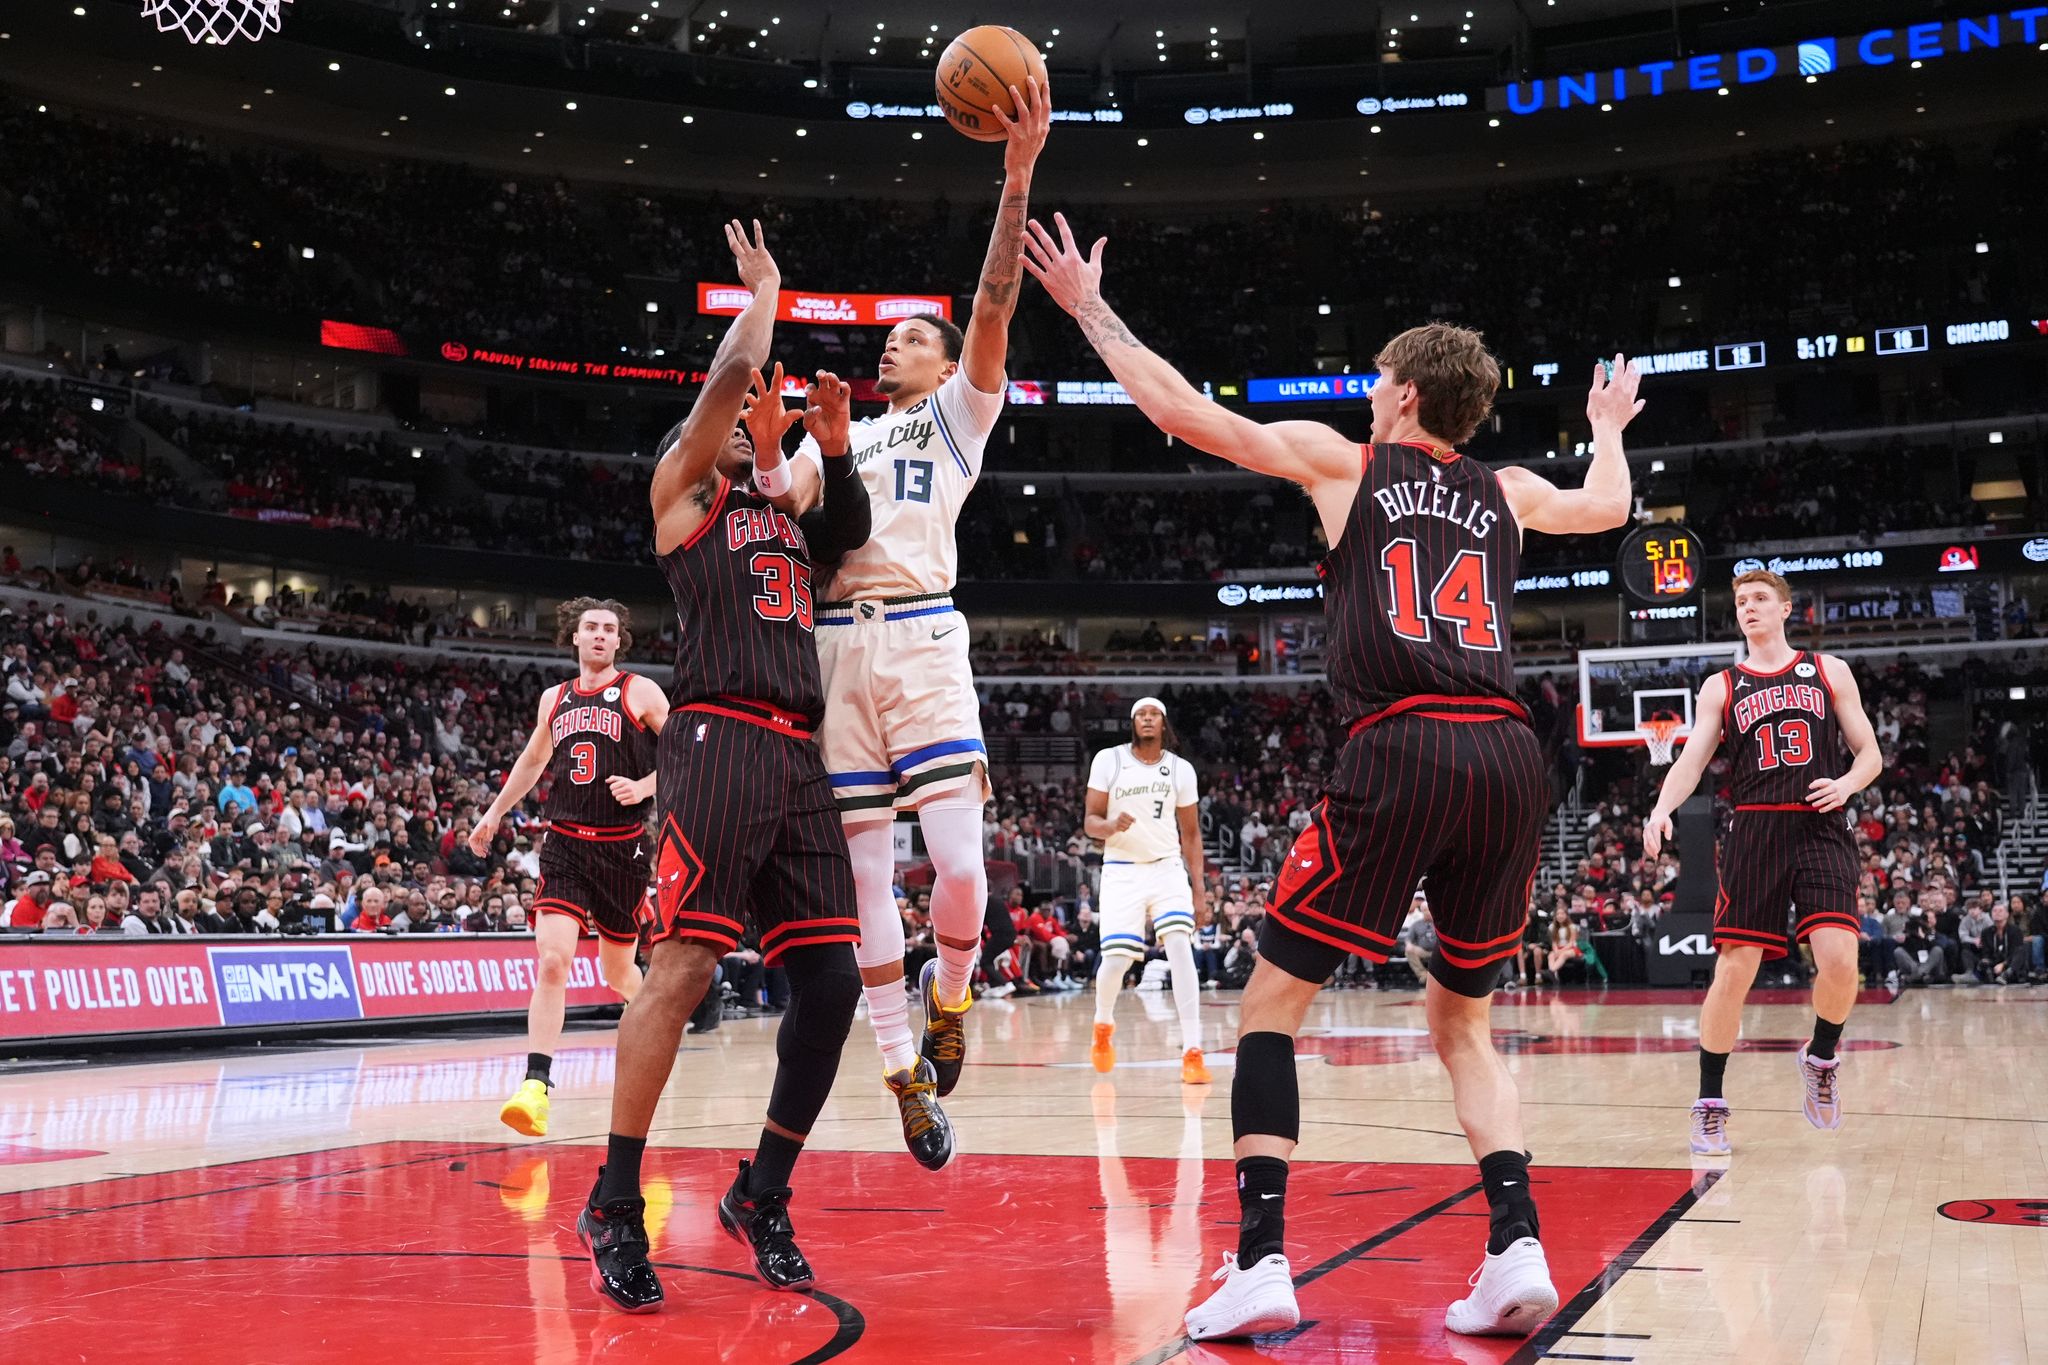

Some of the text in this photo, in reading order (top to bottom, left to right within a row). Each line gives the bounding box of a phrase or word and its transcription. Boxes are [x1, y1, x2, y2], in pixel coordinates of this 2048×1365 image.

[1507, 48, 1777, 115] UNITED
[790, 307, 857, 321] THE PEOPLE
[796, 298, 836, 310] VODKA
[1797, 335, 1838, 360] 5:17
[1946, 320, 2009, 345] CHICAGO
[473, 349, 524, 370] PROUDLY
[529, 357, 578, 374] SERVING
[584, 362, 607, 376] THE
[613, 365, 686, 385] COMMUNITY
[1279, 381, 1330, 396] ULTRA
[887, 419, 935, 451] City
[894, 458, 934, 504] 13
[1373, 481, 1498, 539] BUZELIS
[1645, 538, 1688, 561] 5:17
[1842, 551, 1883, 568] 1899
[750, 551, 814, 631] 35
[1381, 537, 1502, 652] 14
[1571, 570, 1610, 587] 1899
[1647, 606, 1697, 620] TISSOT
[552, 706, 622, 748] CHICAGO
[1734, 684, 1825, 734] CHICAGO
[570, 741, 597, 785] 3
[1755, 718, 1813, 771] 13
[1115, 780, 1172, 800] Cream City
[1153, 800, 1163, 819] 3
[0, 965, 209, 1013] ET PULLED OVER
[249, 962, 350, 1002] NHTSA
[360, 960, 418, 998] DRIVE
[418, 959, 478, 996] SOBER
[479, 958, 504, 993] OR
[504, 958, 536, 992] GET
